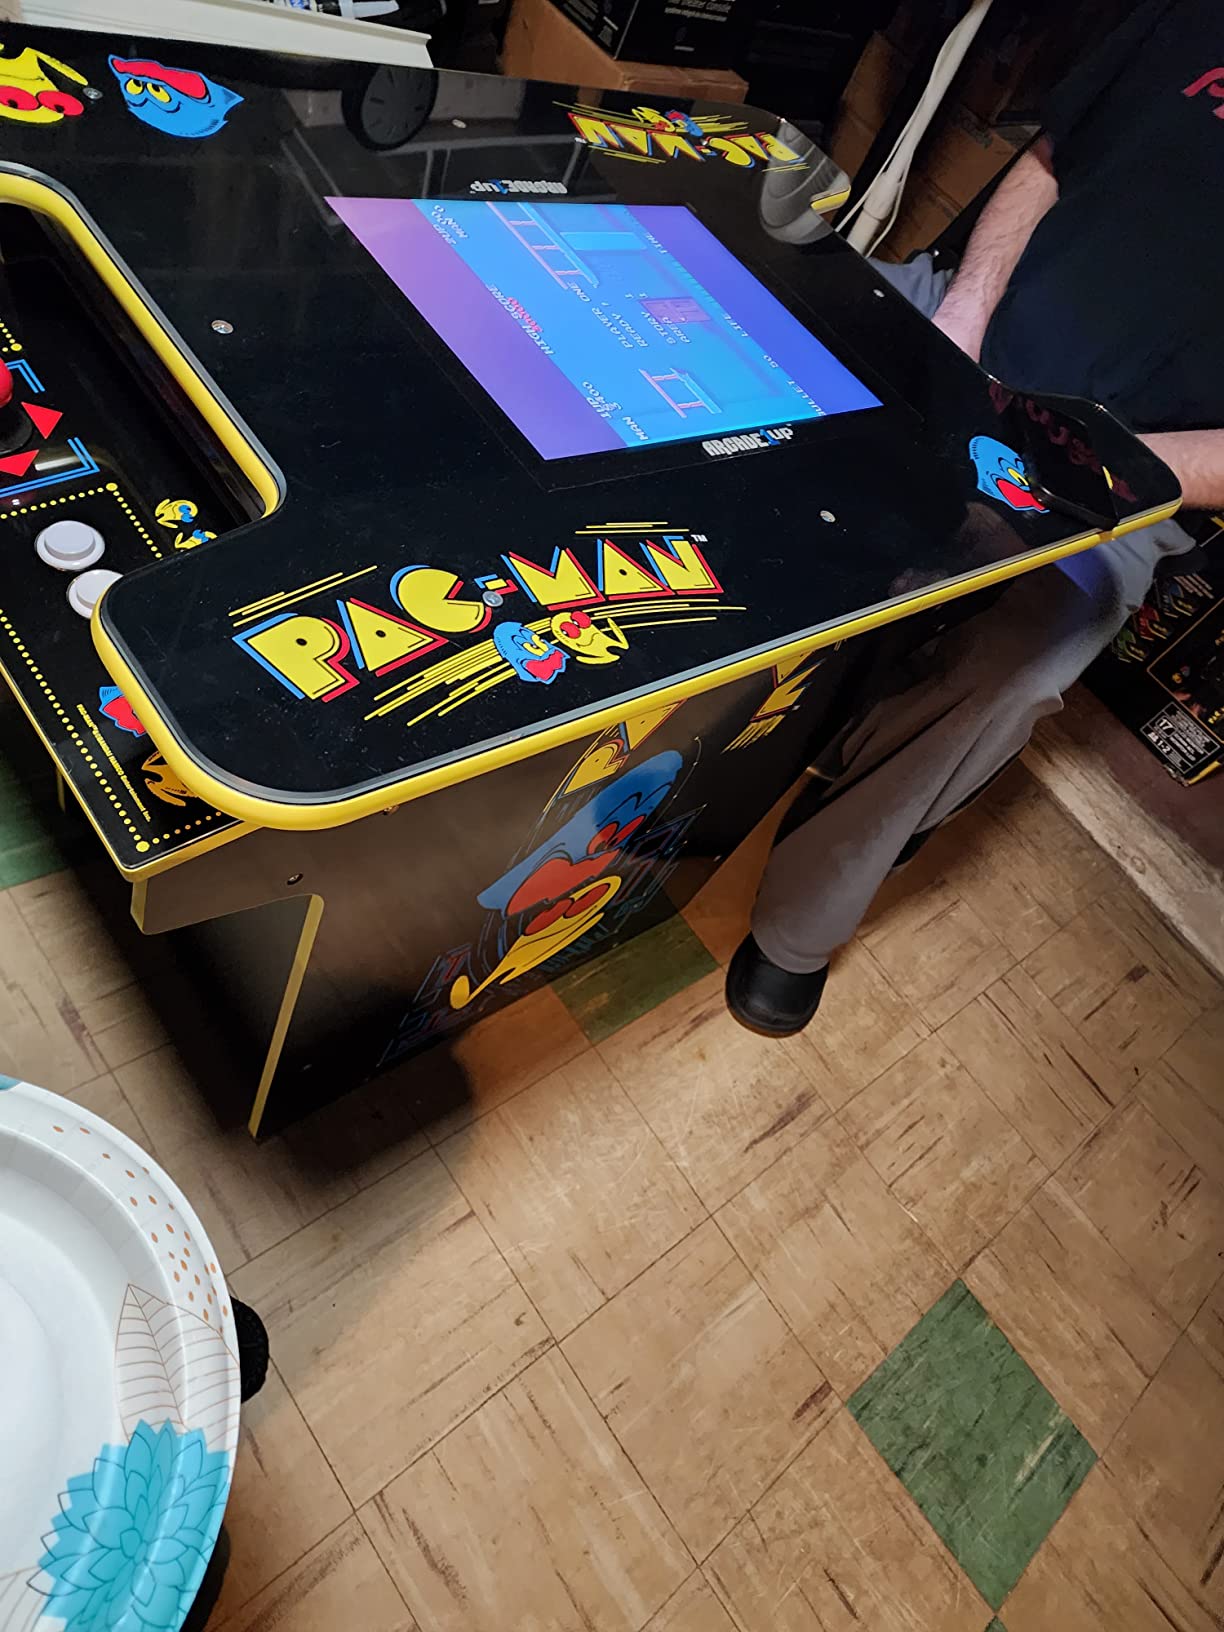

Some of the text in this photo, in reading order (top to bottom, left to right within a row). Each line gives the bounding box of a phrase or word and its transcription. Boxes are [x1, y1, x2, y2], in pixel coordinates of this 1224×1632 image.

[568, 112, 805, 168] PAC-MAN
[485, 283, 555, 356] HIGH SCORE
[591, 307, 634, 348] PLAYER
[611, 312, 648, 347] READY
[641, 311, 677, 344] STORY
[662, 316, 691, 343] AREA
[622, 416, 648, 440] MAN
[702, 427, 794, 456] ARCADE1UP
[231, 536, 725, 702] PAC-MAN
[1159, 718, 1173, 731] 17
